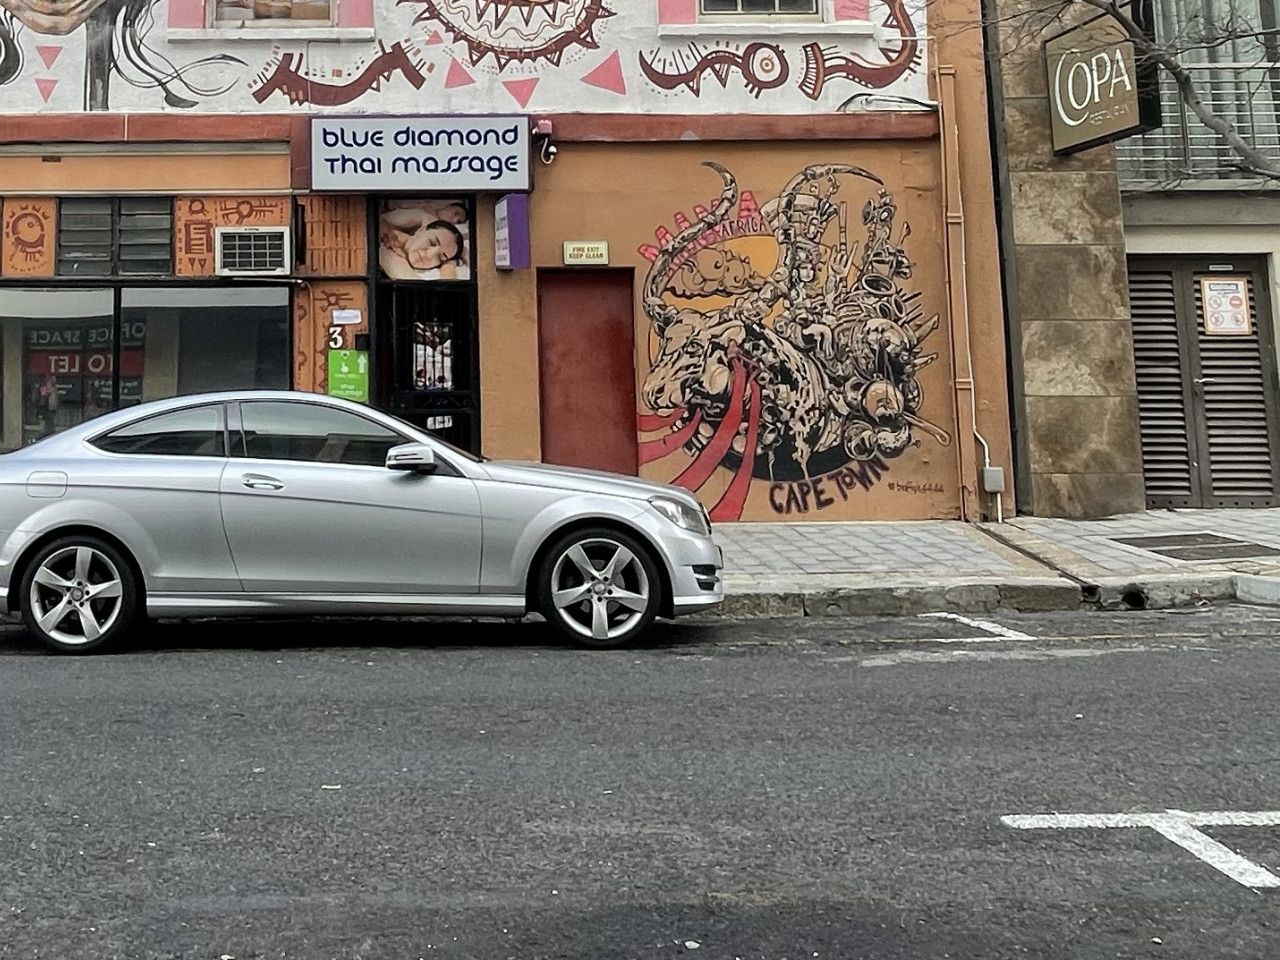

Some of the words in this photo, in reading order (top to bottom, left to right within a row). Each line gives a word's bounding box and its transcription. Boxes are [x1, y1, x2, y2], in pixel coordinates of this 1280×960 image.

[1054, 48, 1132, 127] COPA
[322, 127, 385, 148] blue
[393, 125, 519, 147] diamond
[323, 154, 382, 175] Thai
[391, 154, 519, 181] massage
[328, 326, 344, 349] 3
[769, 477, 834, 514] CAPE
[826, 453, 890, 502] TOWN
